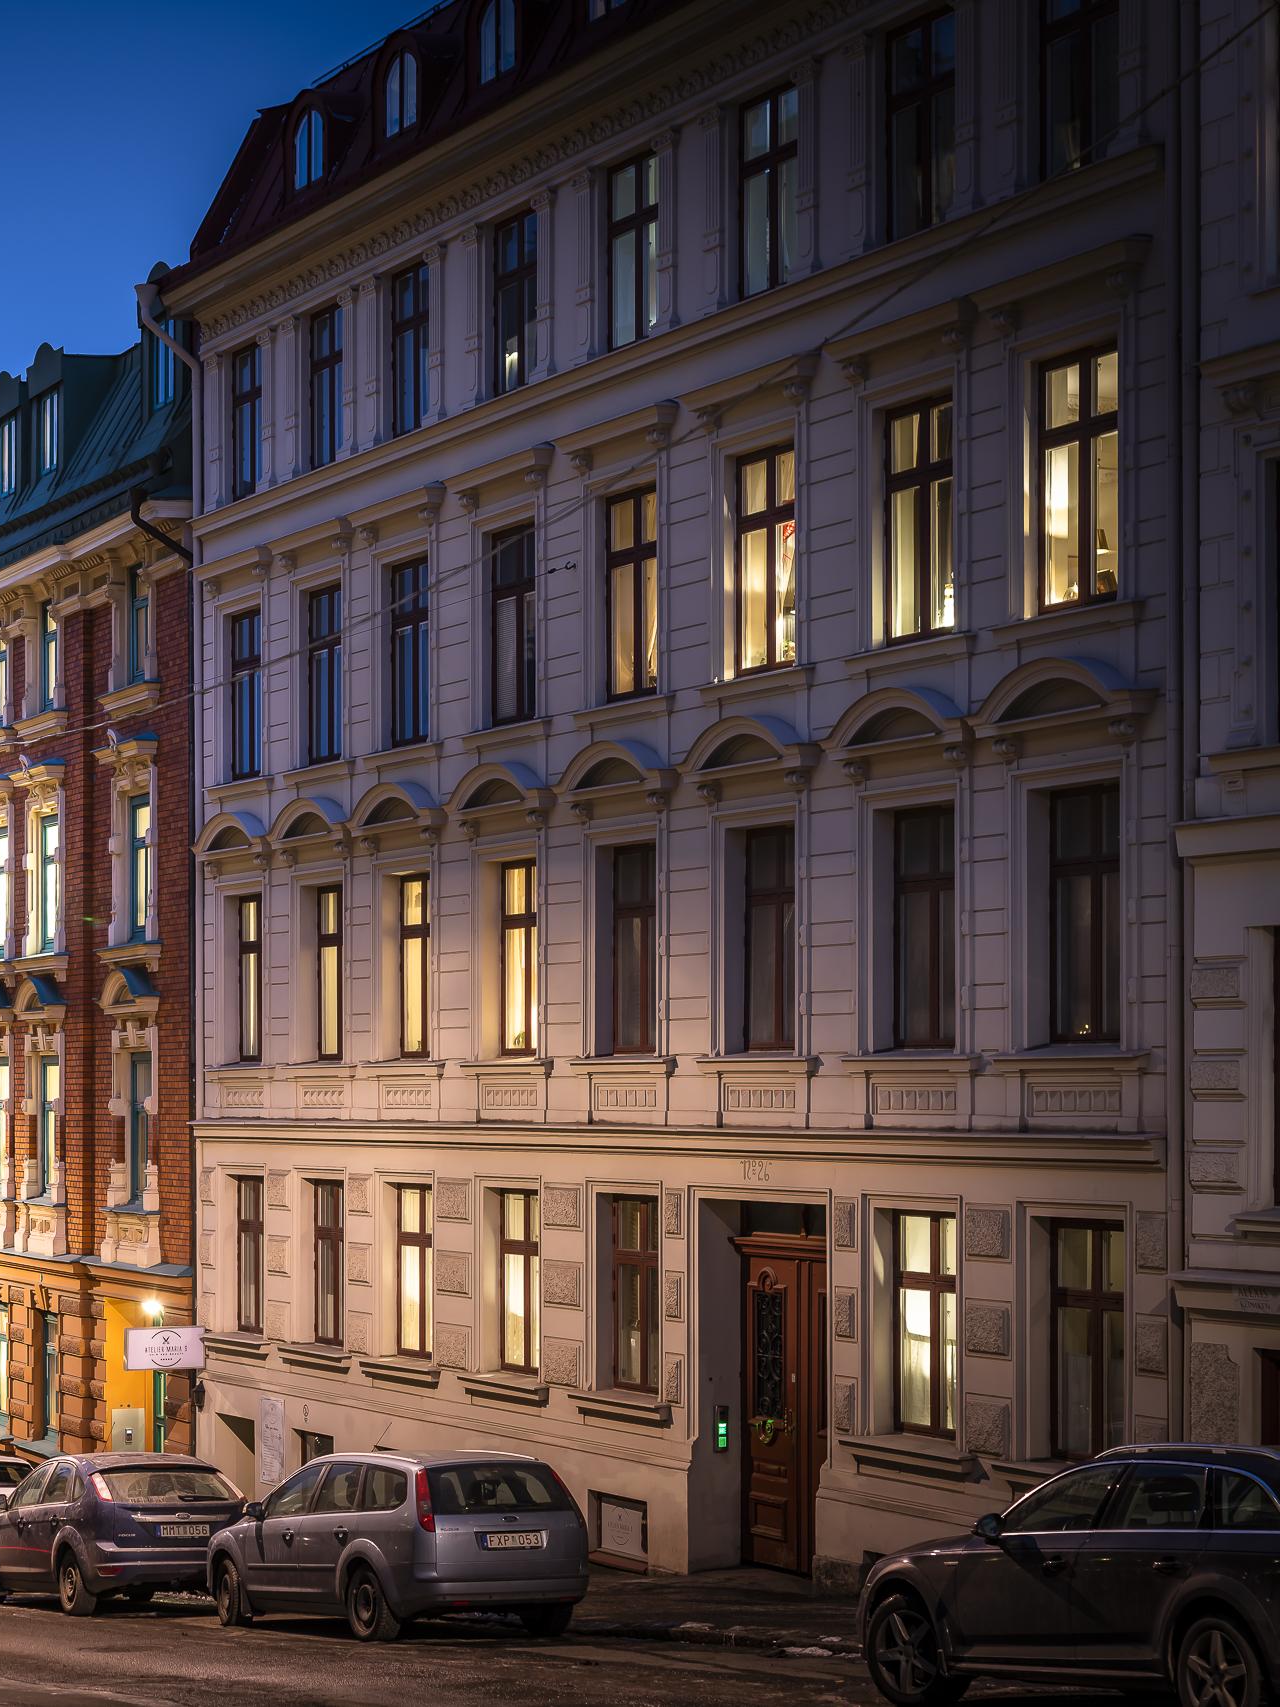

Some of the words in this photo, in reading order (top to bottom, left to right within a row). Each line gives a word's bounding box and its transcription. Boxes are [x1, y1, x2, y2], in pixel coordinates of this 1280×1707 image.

[162, 1525, 181, 1535] MMT
[188, 1525, 208, 1535] 056
[489, 1535, 510, 1546] FXP
[518, 1534, 540, 1545] 053
